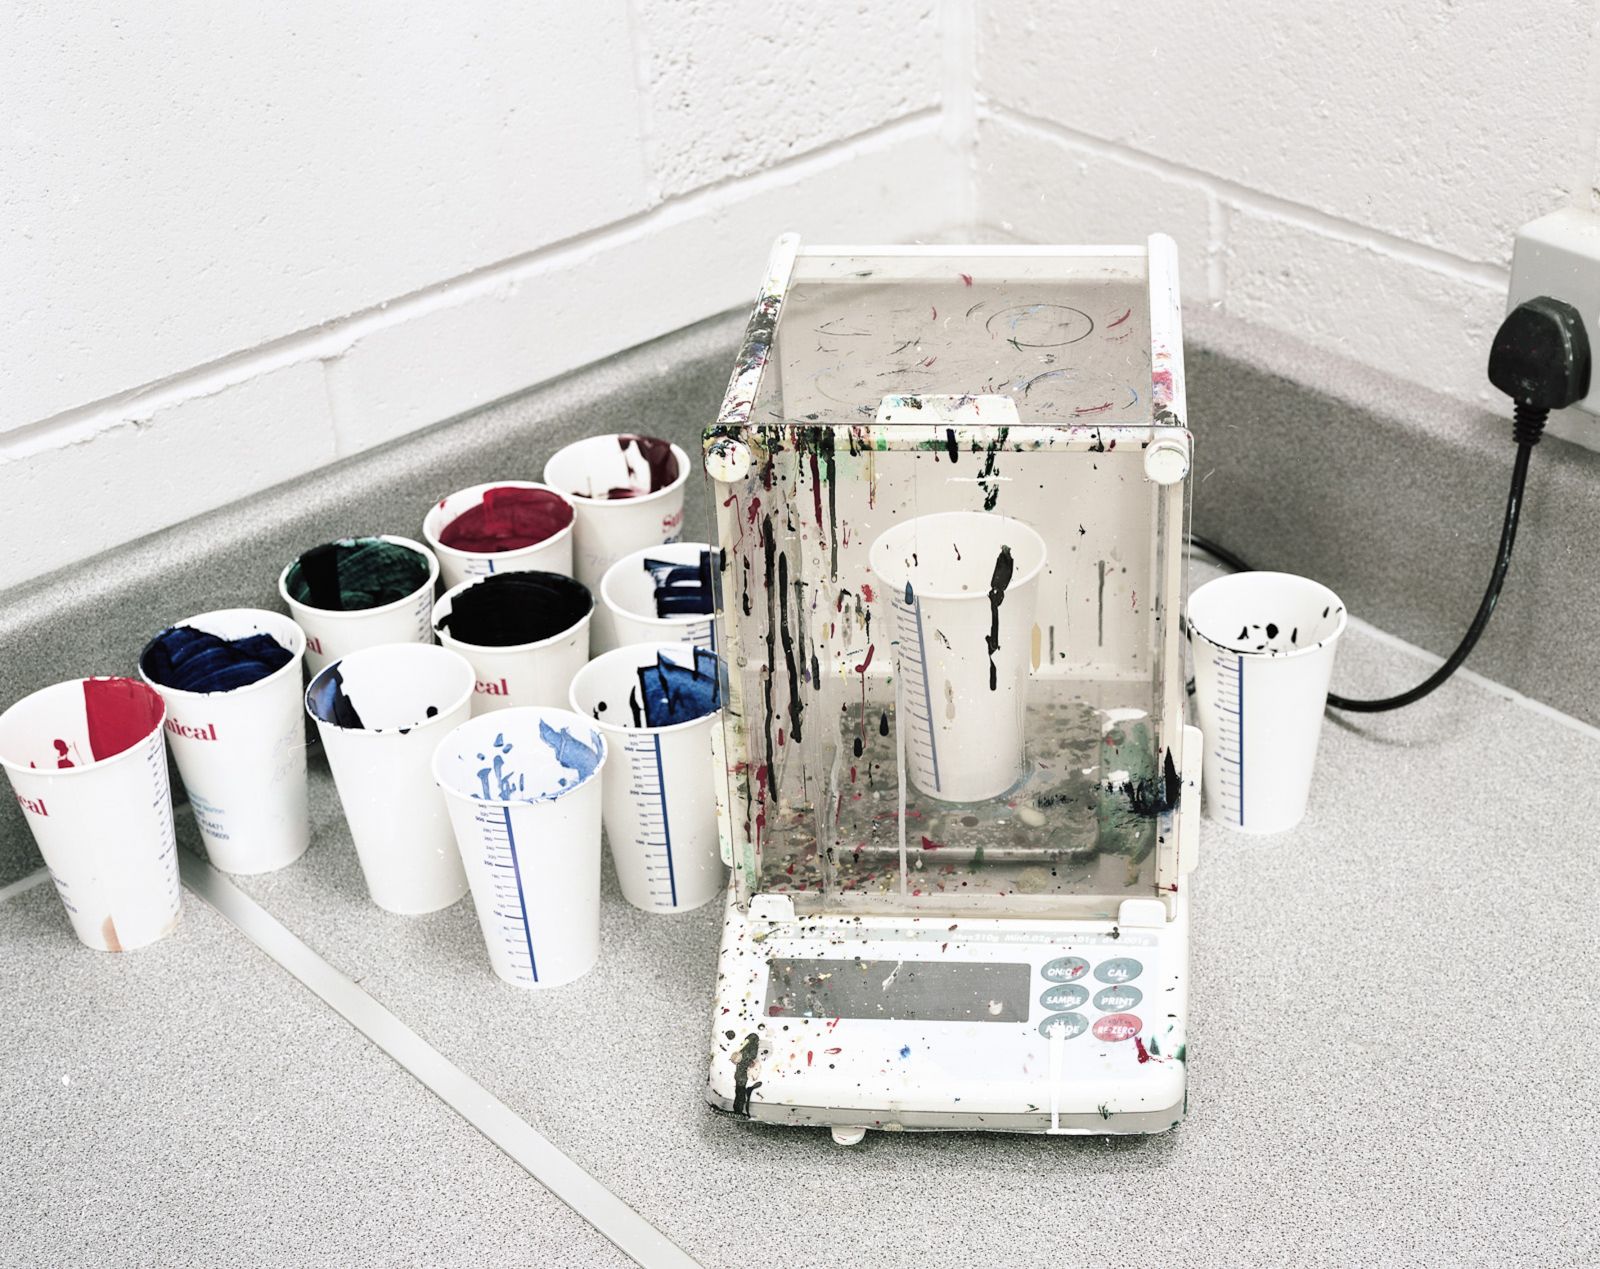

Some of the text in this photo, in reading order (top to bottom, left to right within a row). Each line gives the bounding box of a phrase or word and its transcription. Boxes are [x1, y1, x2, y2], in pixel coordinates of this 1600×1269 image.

[1107, 968, 1129, 977] CAL
[1046, 996, 1082, 1005] SAMPLE
[1101, 996, 1135, 1006] PRINT
